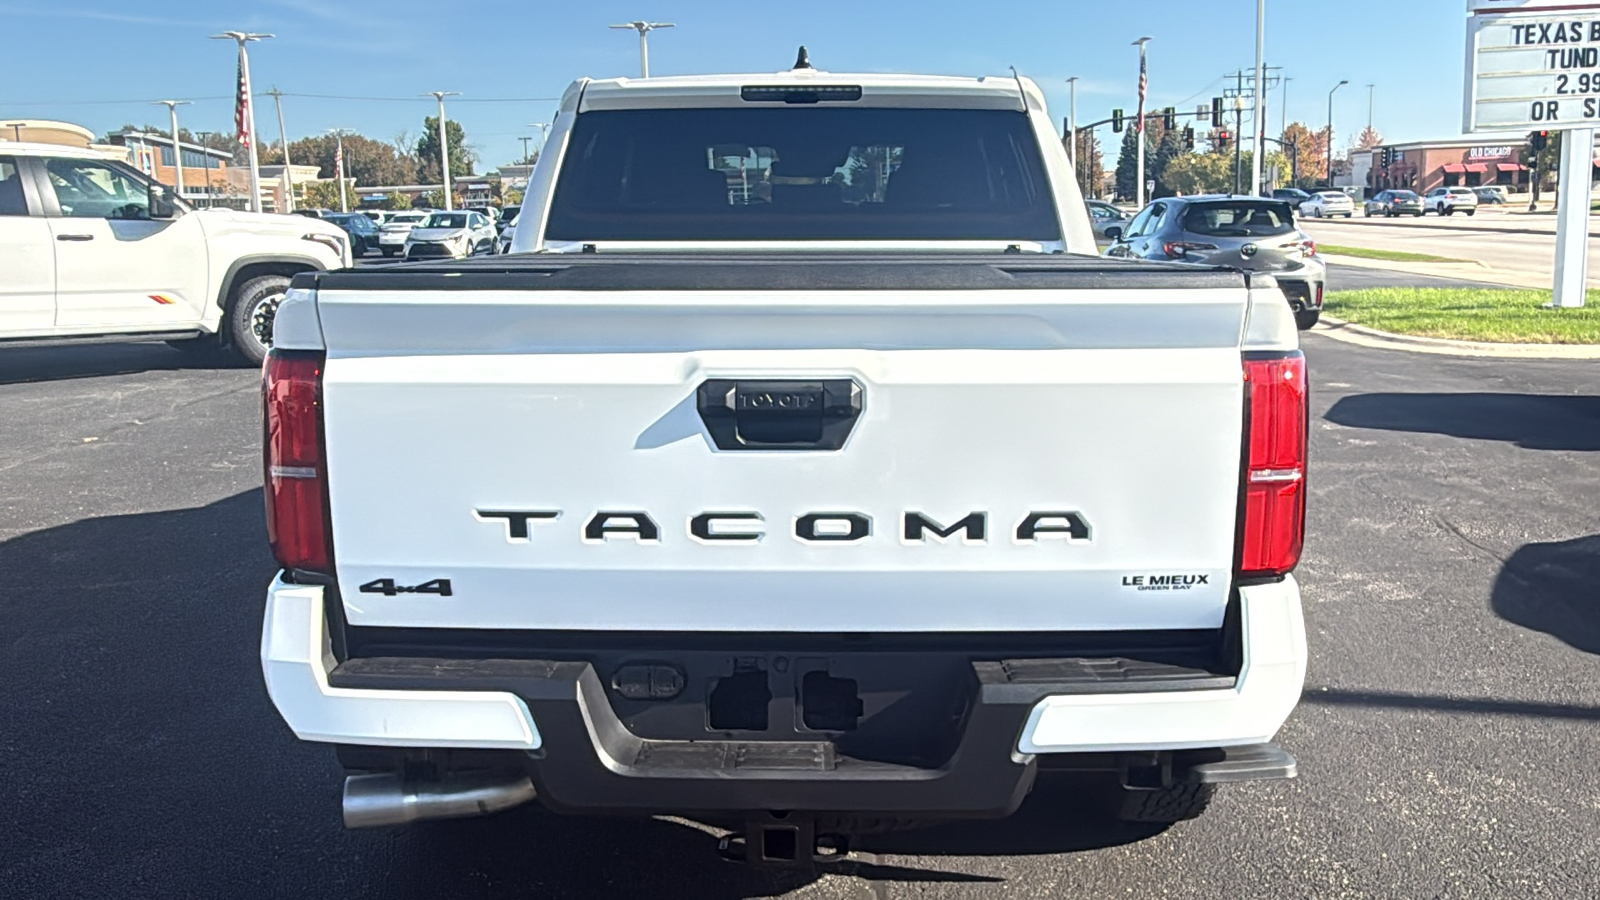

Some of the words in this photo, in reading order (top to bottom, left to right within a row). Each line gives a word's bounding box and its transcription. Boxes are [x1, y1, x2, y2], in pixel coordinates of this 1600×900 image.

[1512, 22, 1583, 45] TEXAS
[1547, 47, 1598, 69] TUND
[1556, 73, 1600, 94] 2.99
[1531, 101, 1559, 121] OR
[1583, 98, 1600, 118] S
[1470, 147, 1483, 157] OLD
[1484, 146, 1512, 157] CHICAGO
[740, 393, 816, 408] TOYOTA
[474, 509, 1092, 543] TACOMA
[1122, 576, 1144, 586] LE
[1149, 574, 1209, 585] MIEUX
